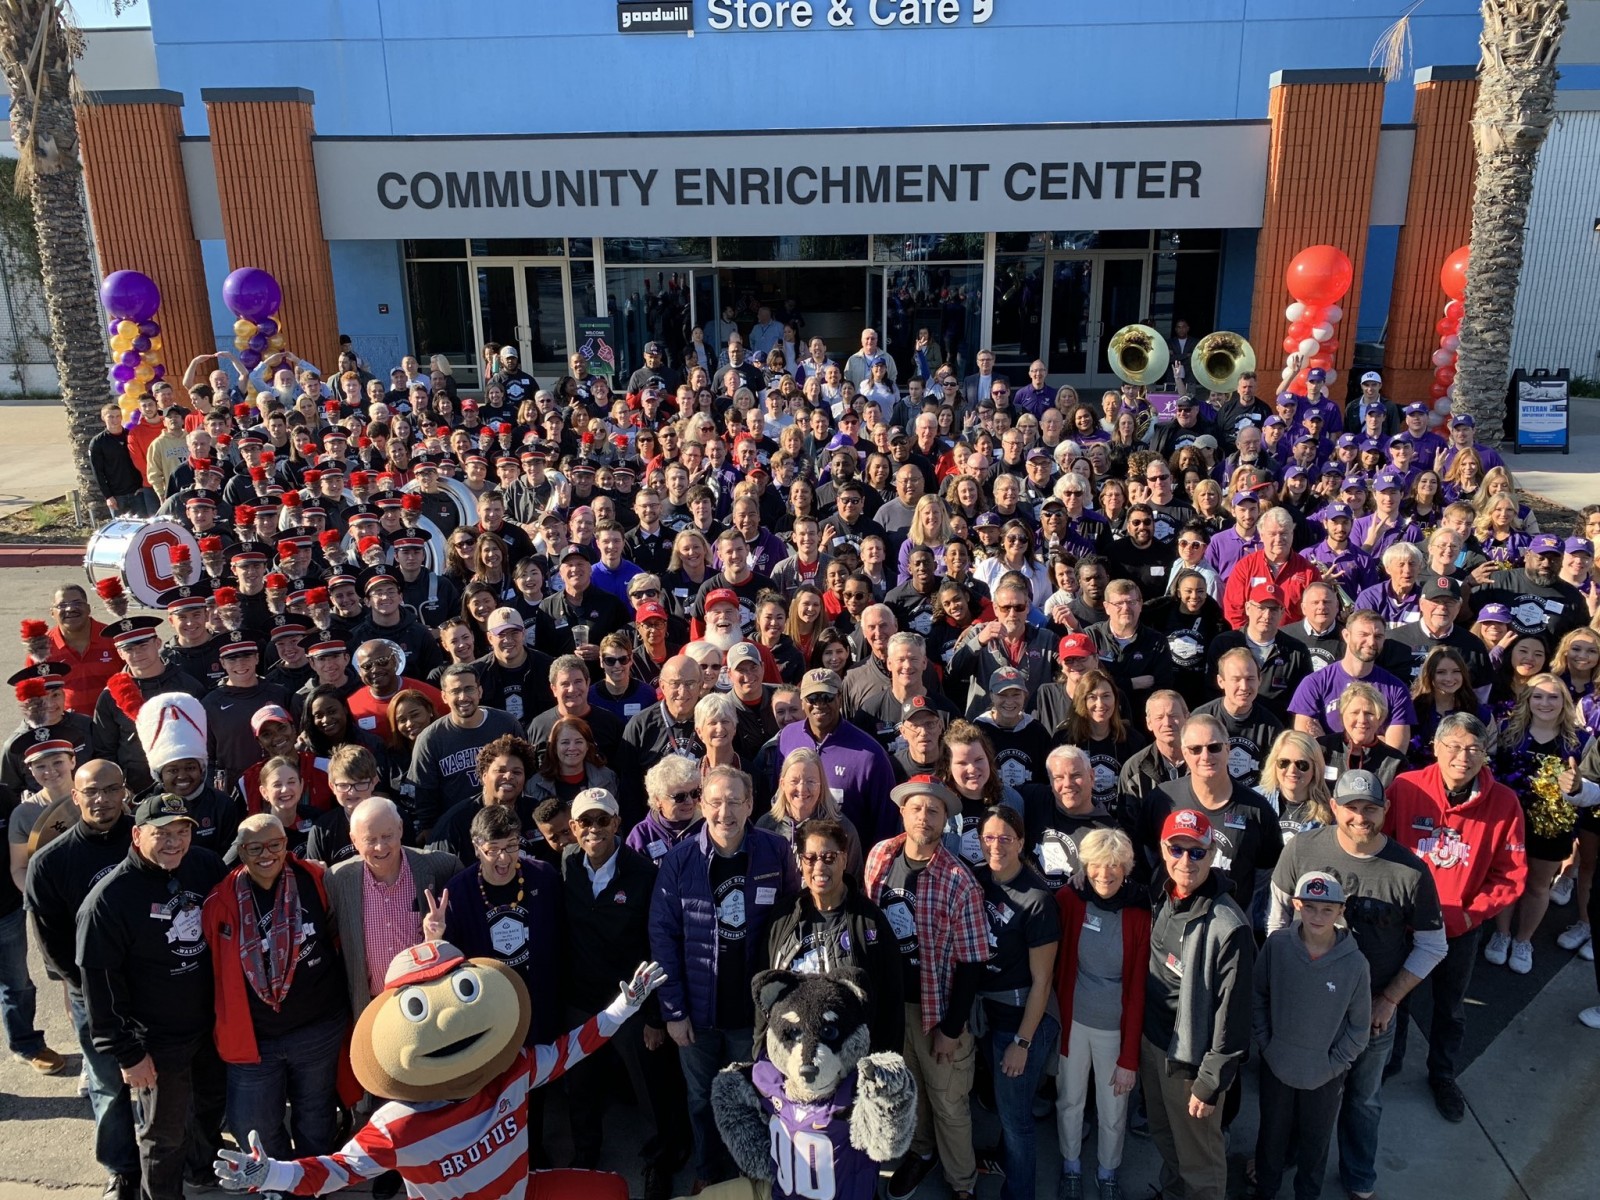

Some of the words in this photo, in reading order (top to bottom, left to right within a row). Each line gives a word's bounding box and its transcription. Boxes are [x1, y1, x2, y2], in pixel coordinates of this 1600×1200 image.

[622, 6, 688, 27] goodwill
[708, 0, 813, 29] Store
[827, 0, 854, 27] &
[377, 169, 659, 210] COMMUNITY
[675, 164, 989, 206] ENRICHMENT
[1004, 160, 1201, 201] CENTER
[835, 766, 846, 776] W
[718, 881, 732, 893] OHIO
[410, 942, 440, 965] O
[439, 1116, 517, 1178] BRUTUS
